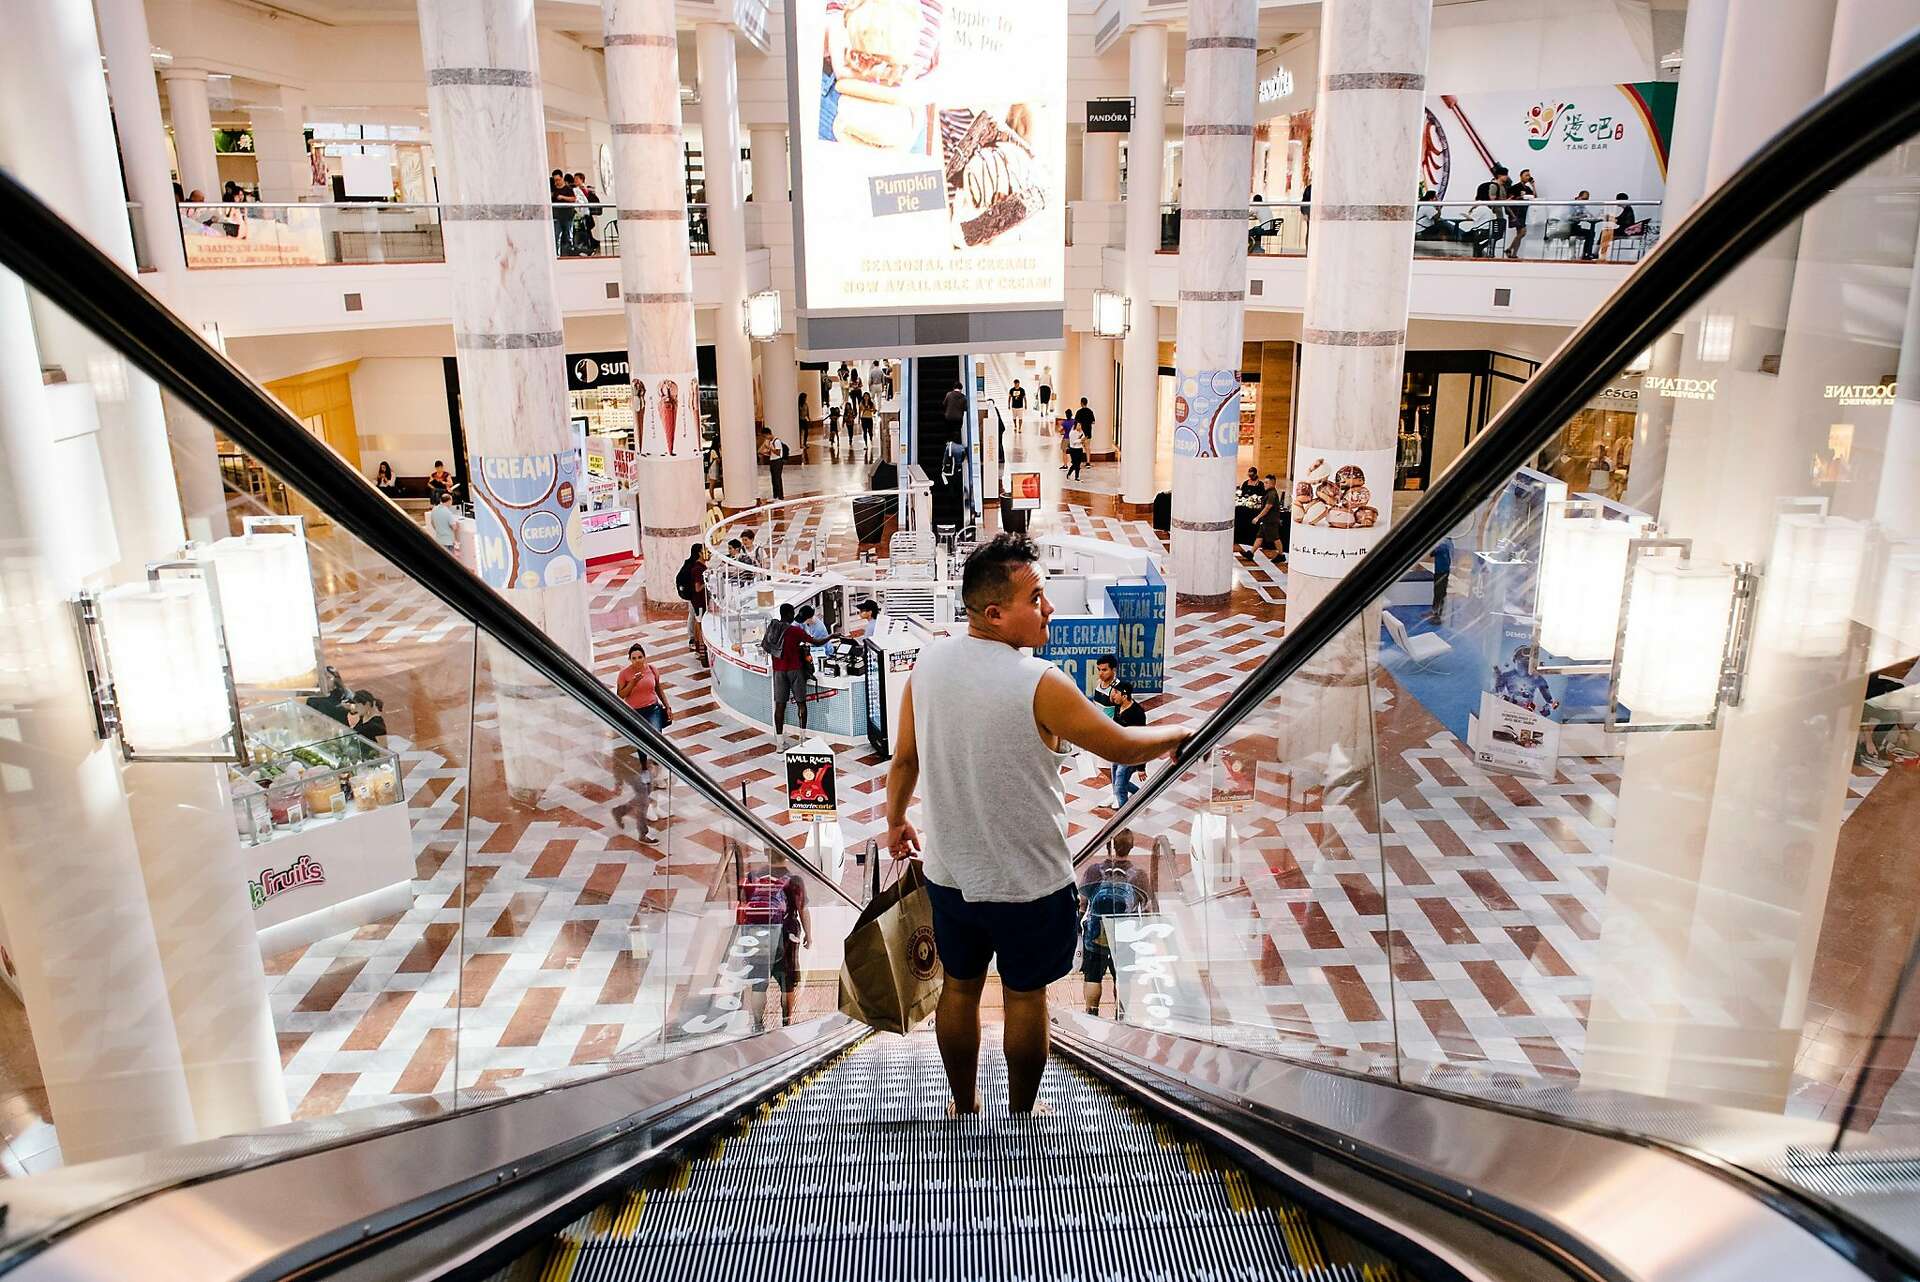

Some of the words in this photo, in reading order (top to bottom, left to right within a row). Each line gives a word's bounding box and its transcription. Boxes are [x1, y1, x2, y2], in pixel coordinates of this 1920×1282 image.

[1566, 143, 1589, 151] TANG
[875, 173, 937, 195] Pumpkin
[897, 194, 921, 212] Pie
[485, 457, 551, 480] CREAM
[524, 525, 560, 540] CREAM
[1050, 625, 1070, 645] ICE
[1073, 624, 1118, 645] CREAM
[1050, 646, 1117, 656] SANDWICHES
